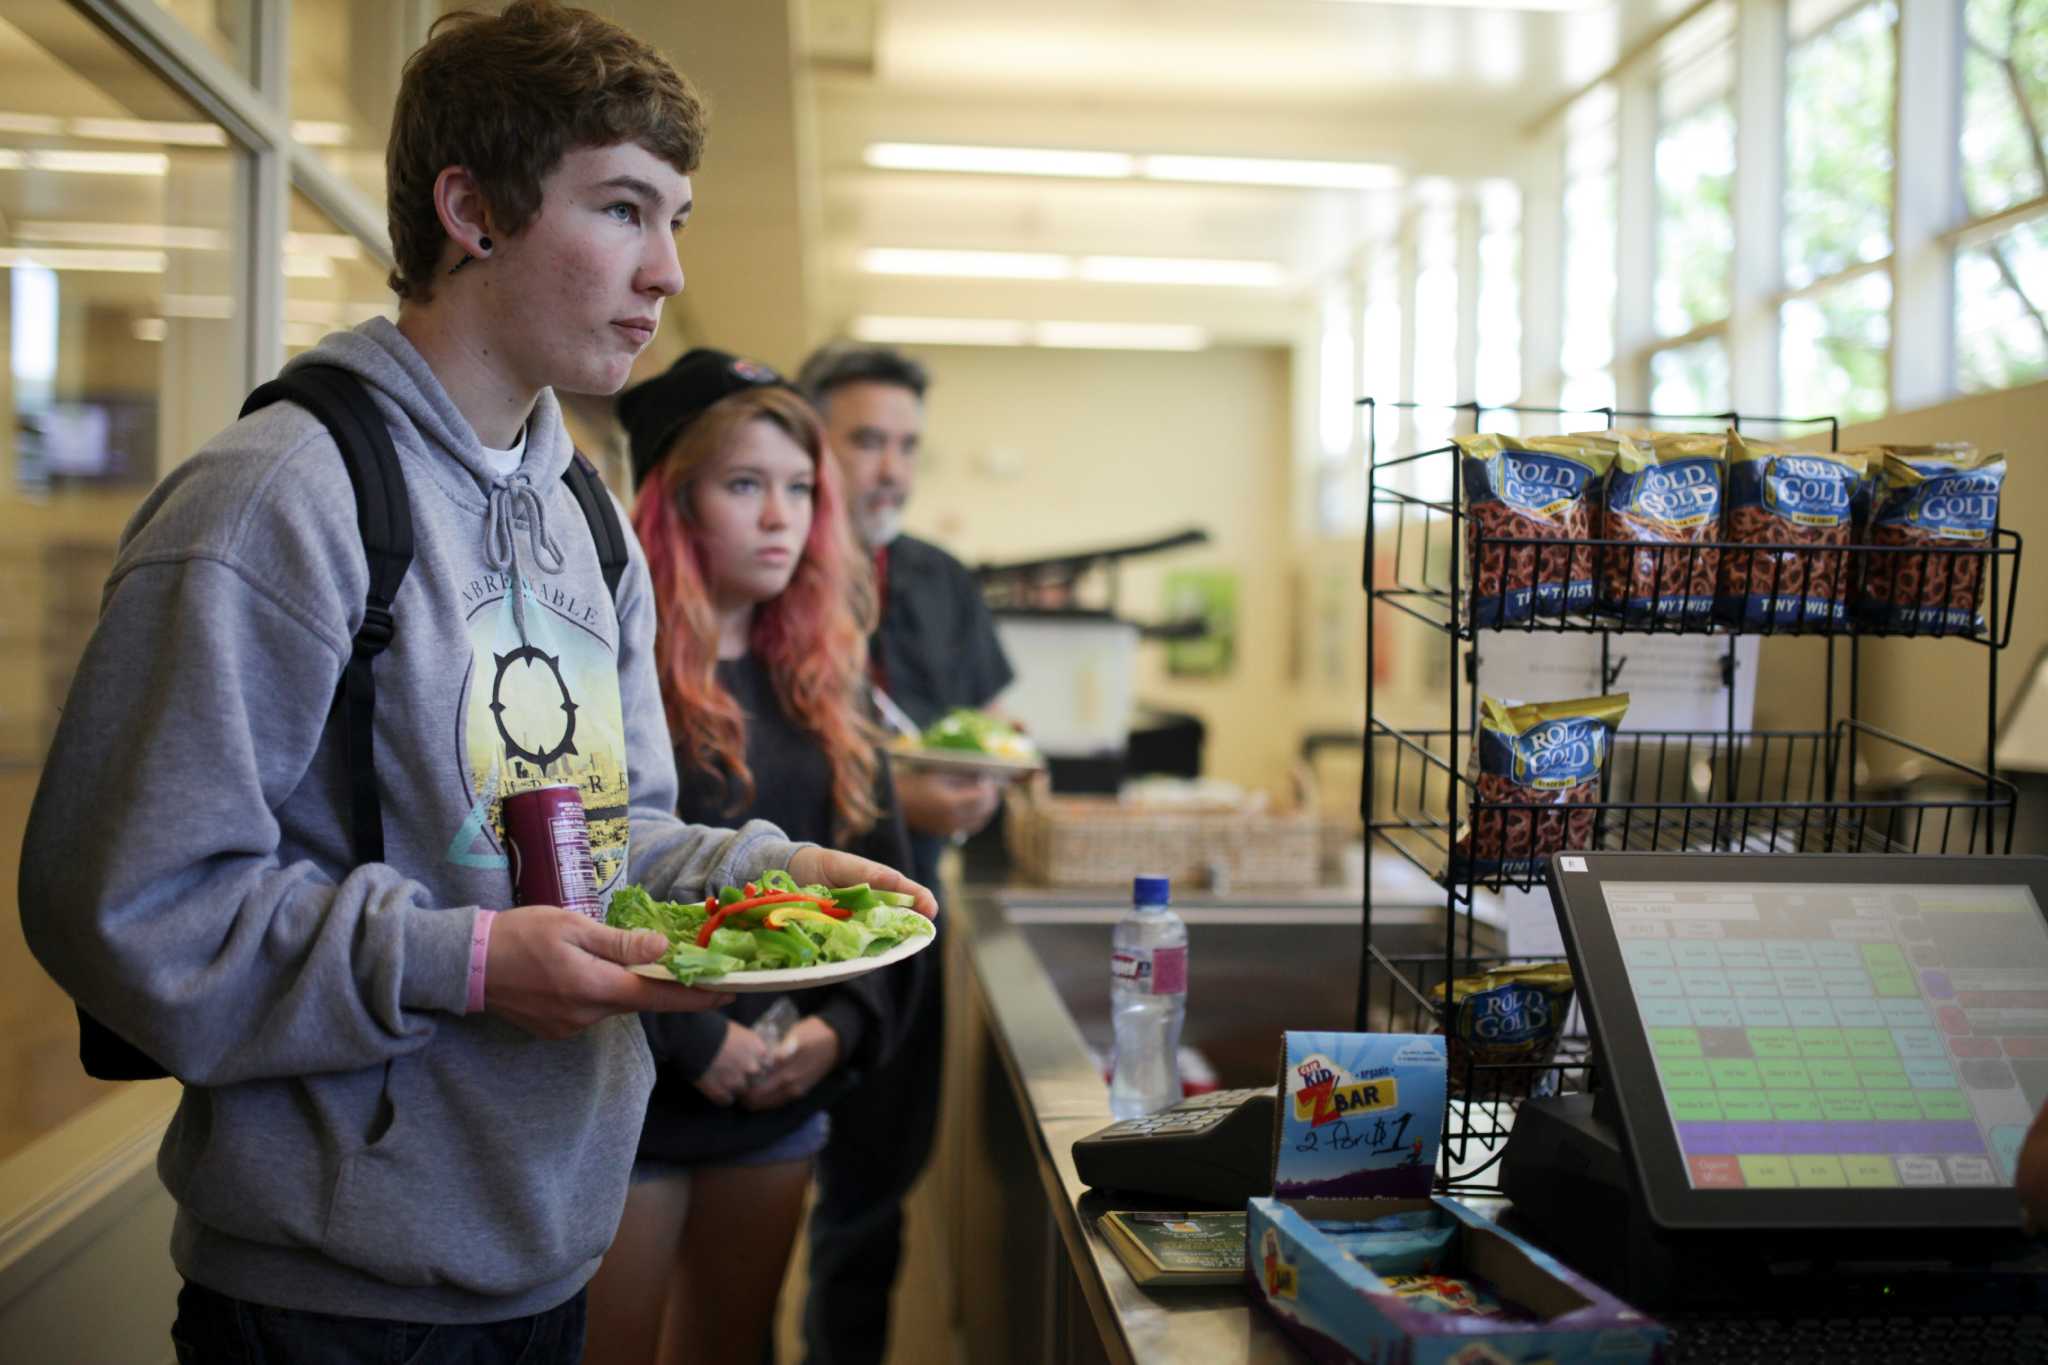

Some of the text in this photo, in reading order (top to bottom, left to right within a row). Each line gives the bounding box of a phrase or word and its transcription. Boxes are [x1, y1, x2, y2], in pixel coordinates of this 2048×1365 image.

[1509, 458, 1576, 488] ROLD
[1939, 474, 2000, 497] ROLD
[1778, 477, 1850, 508] GOLD
[1921, 495, 1998, 521] GOLD
[1487, 989, 1544, 1017] ROLD
[1475, 1006, 1549, 1039] GOLD
[1304, 1068, 1334, 1089] KID
[1334, 1085, 1381, 1113] BAR
[1296, 1131, 1319, 1152] 2
